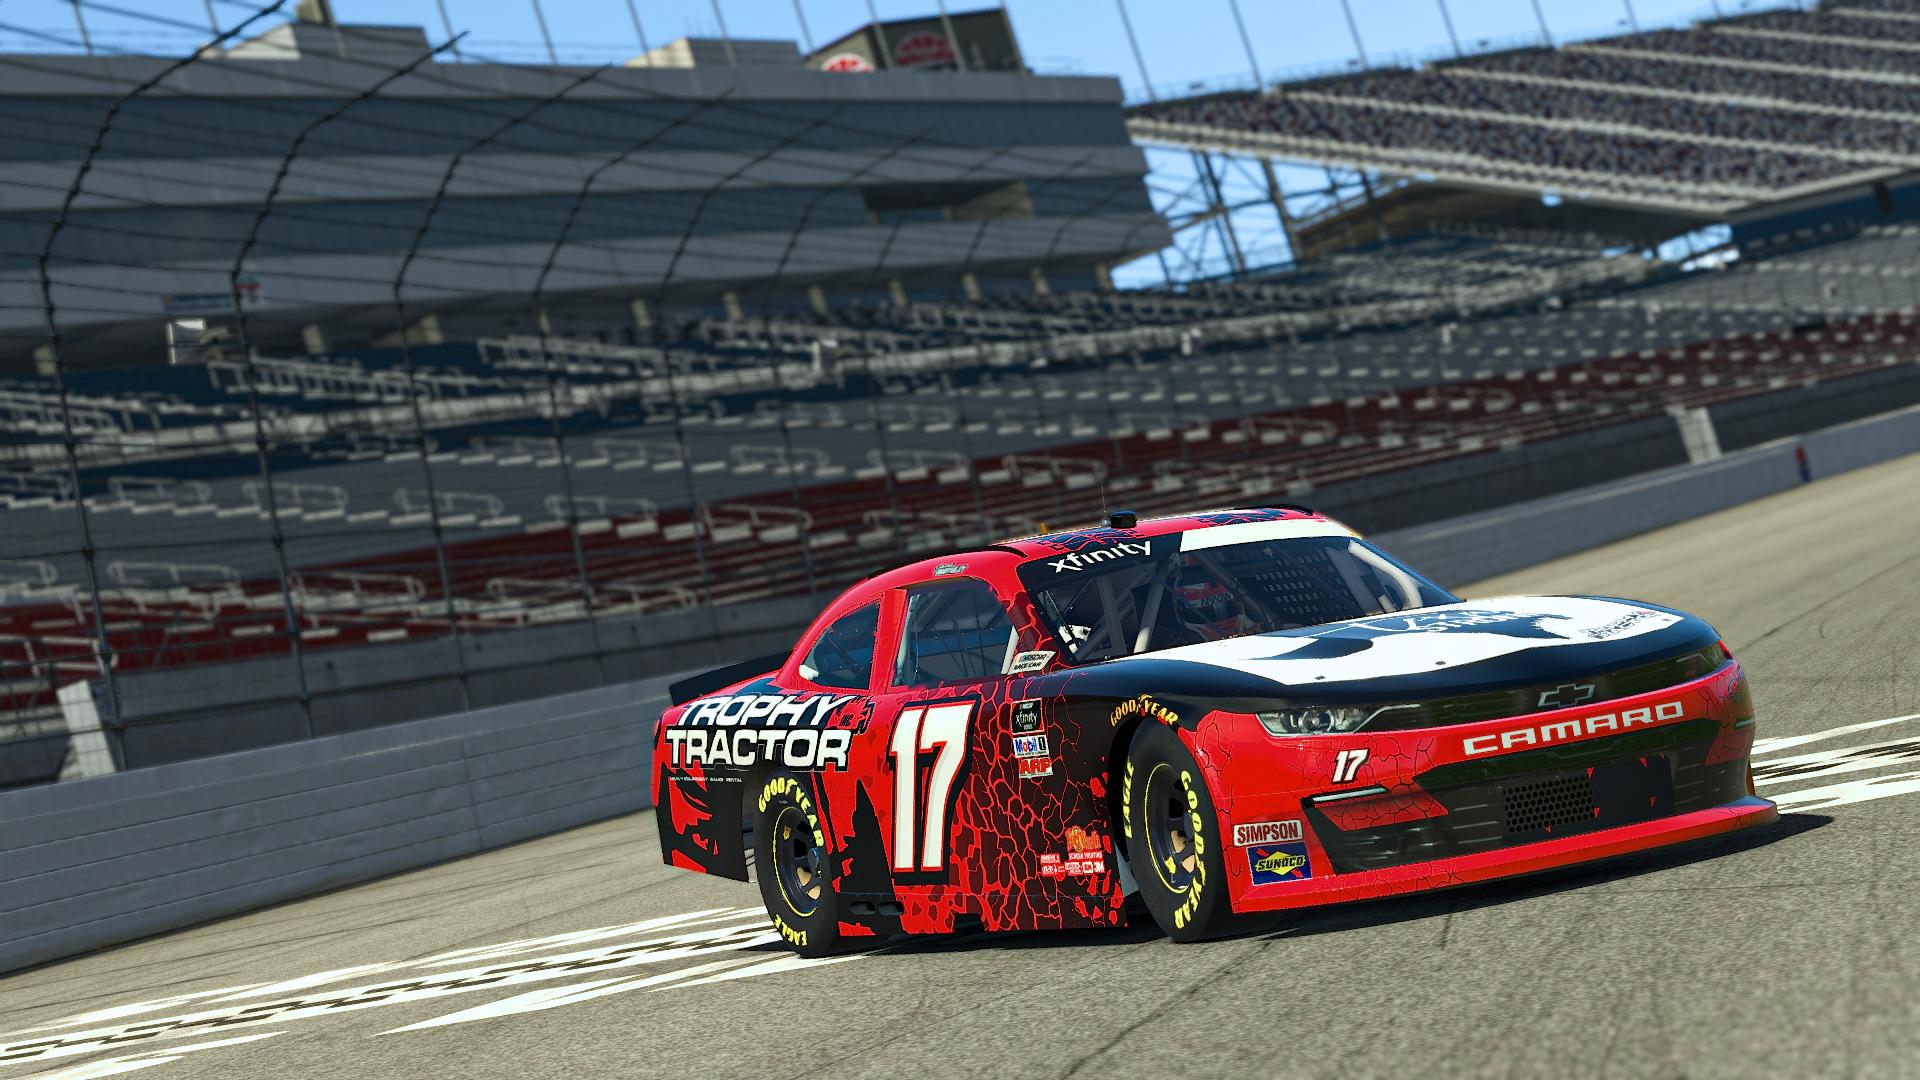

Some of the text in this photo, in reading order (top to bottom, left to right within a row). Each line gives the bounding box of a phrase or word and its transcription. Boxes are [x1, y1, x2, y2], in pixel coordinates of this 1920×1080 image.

[1047, 540, 1151, 574] xfinity
[678, 694, 858, 727] TROPHY
[1110, 693, 1179, 727] GOODYEAR
[1014, 738, 1038, 753] Mobil
[1462, 701, 1685, 756] CAMARO
[665, 729, 852, 767] TRACTOR
[1020, 759, 1051, 774] ARP
[1332, 749, 1369, 784] 17
[889, 699, 977, 873] 17
[1122, 760, 1135, 839] EAGLE
[758, 777, 825, 848] GOODYEAR
[1173, 770, 1206, 929] GOODYEAR
[1236, 821, 1299, 845] SIMPSON
[1256, 855, 1306, 871] SUNOCO
[774, 914, 808, 946] EAGLE
